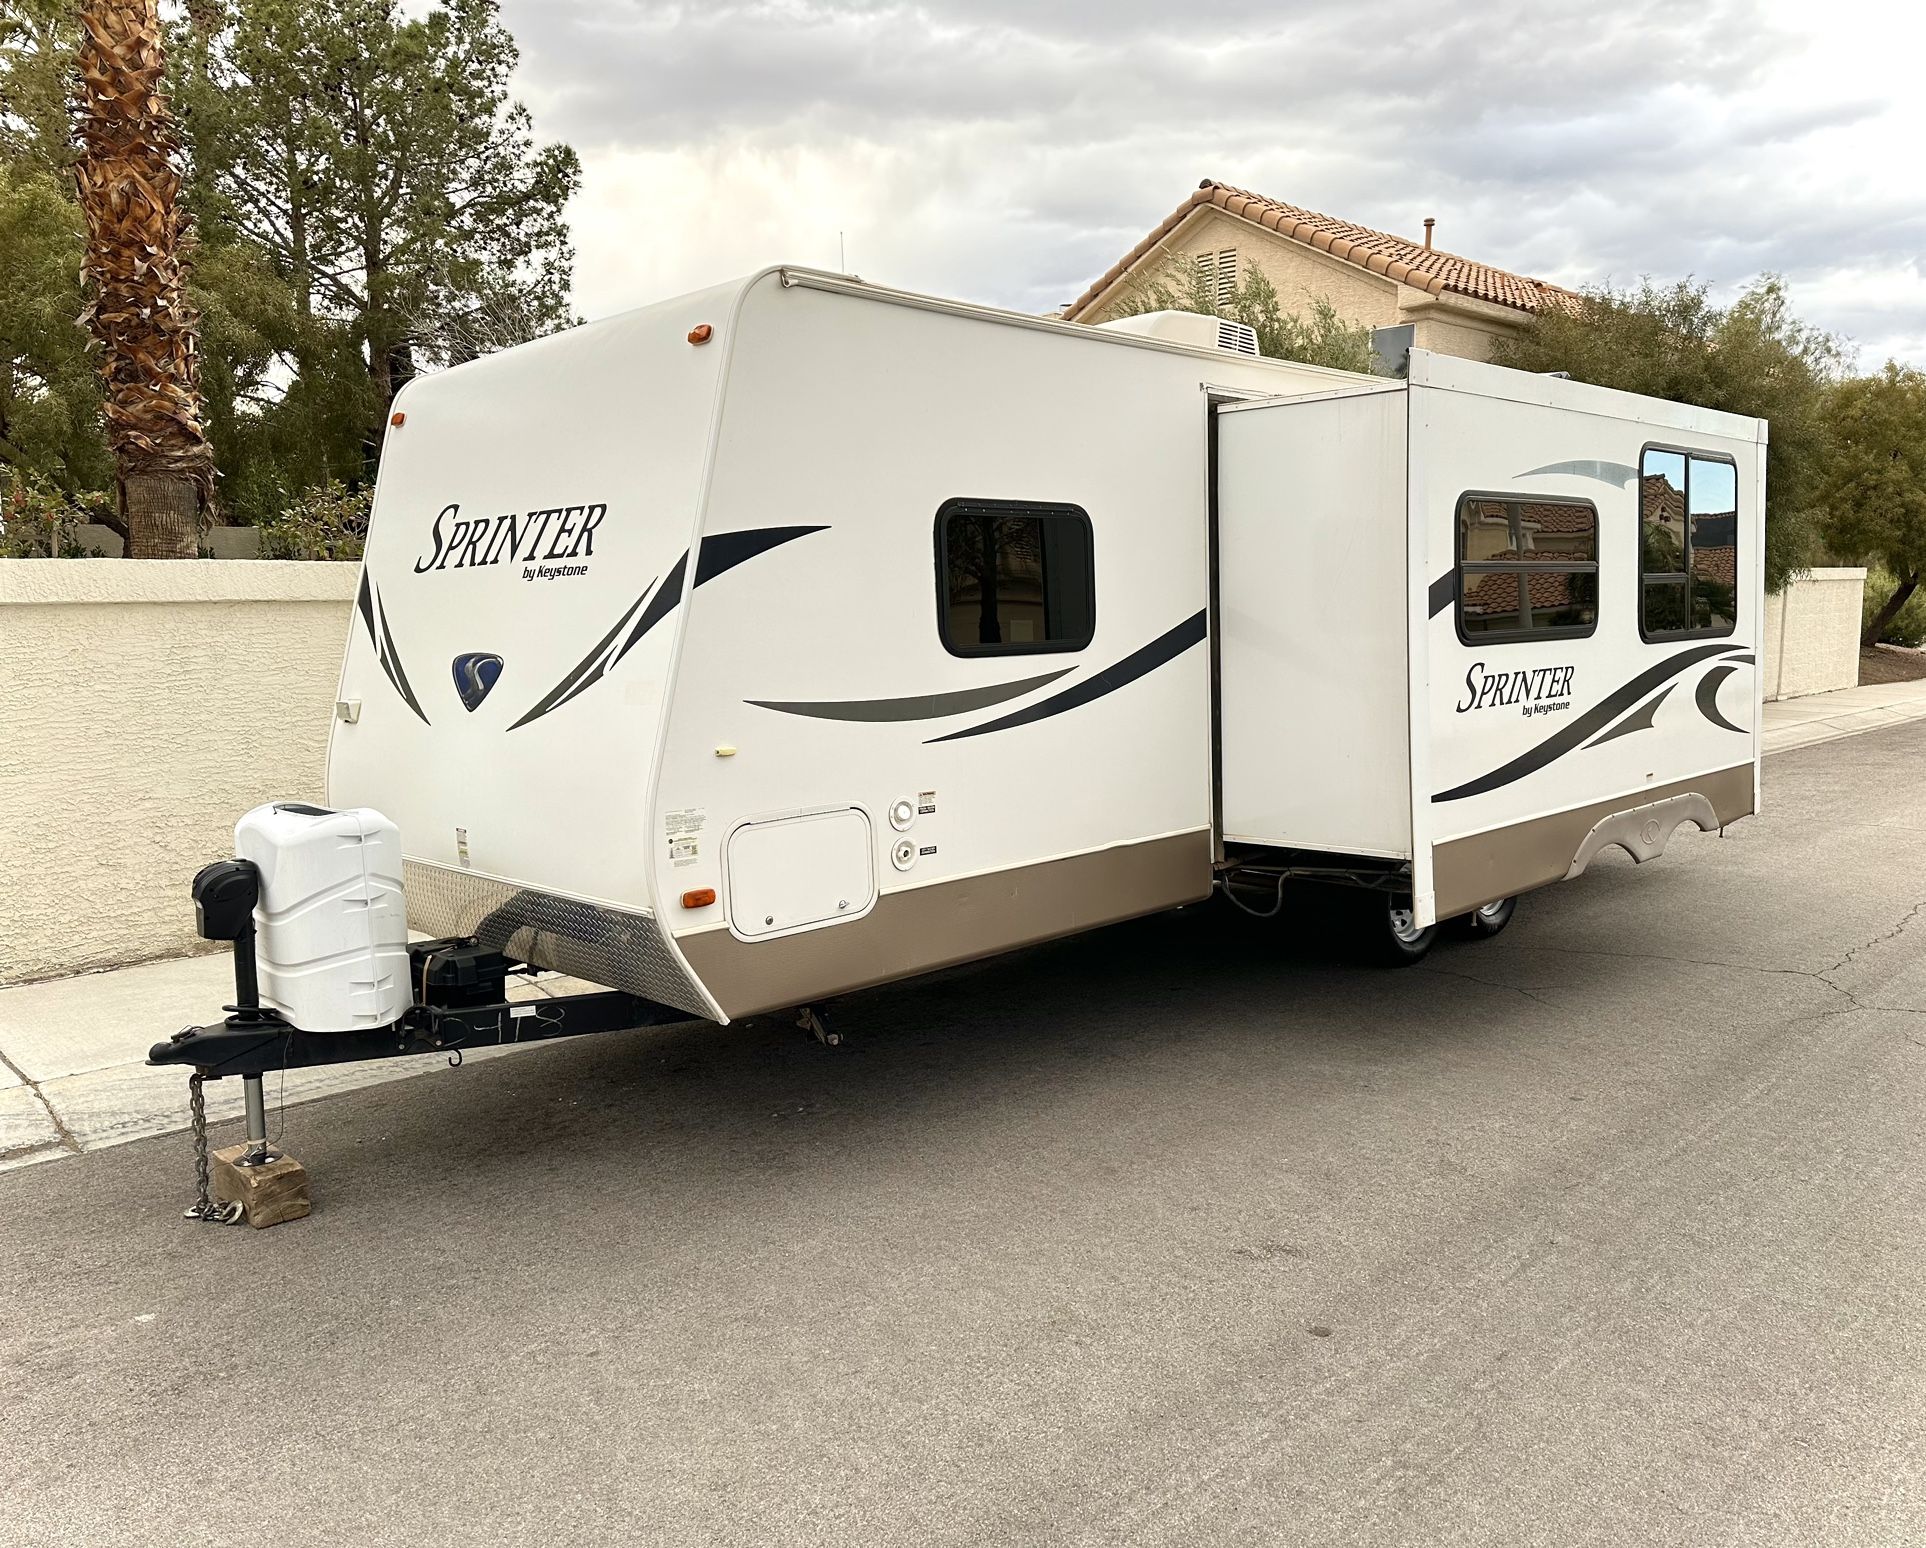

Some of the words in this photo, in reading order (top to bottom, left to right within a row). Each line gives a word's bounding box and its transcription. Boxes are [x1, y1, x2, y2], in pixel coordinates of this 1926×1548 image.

[414, 504, 607, 573] SPRINTER
[522, 566, 536, 581] by
[537, 565, 588, 580] Keystone
[1456, 662, 1575, 713] SPRINTER
[1522, 704, 1533, 717] by
[1534, 702, 1570, 715] Keystone
